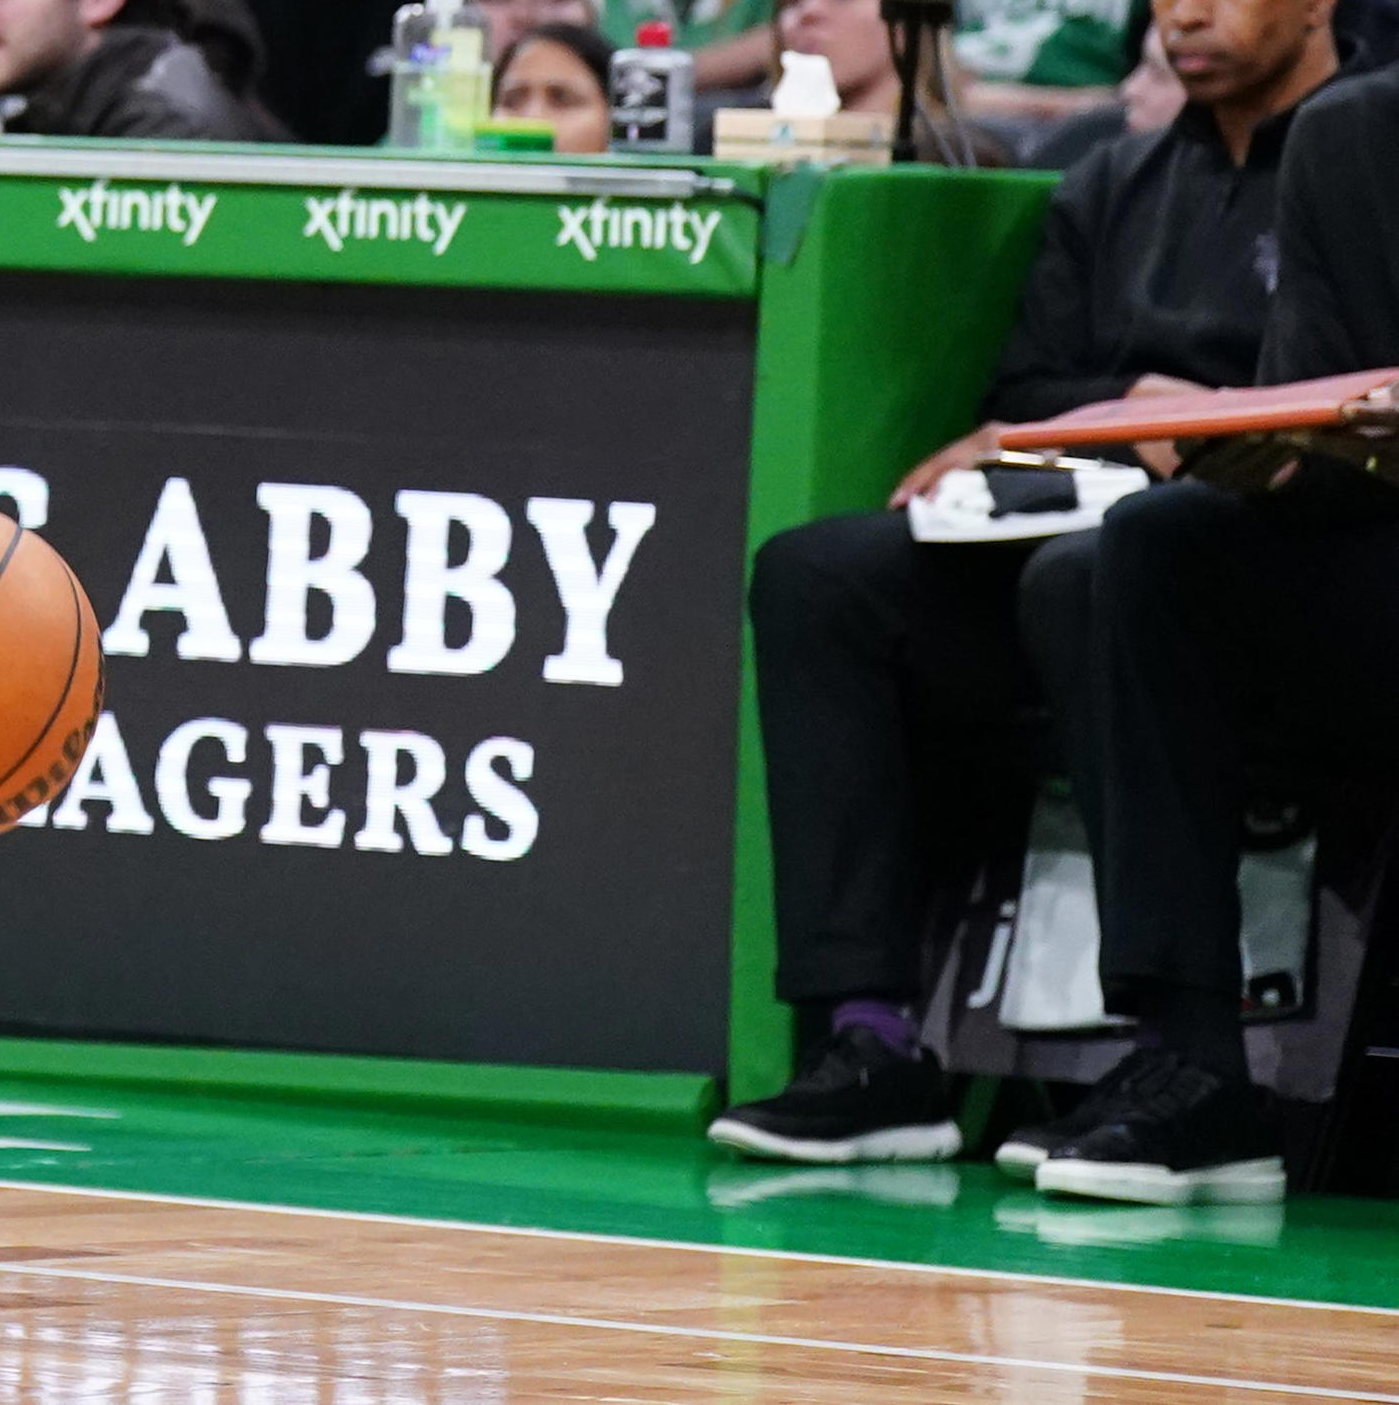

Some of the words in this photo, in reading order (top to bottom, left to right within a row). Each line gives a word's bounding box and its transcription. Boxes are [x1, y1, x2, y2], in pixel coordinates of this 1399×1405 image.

[57, 179, 217, 246] xfinity
[304, 188, 467, 255] xfinity
[557, 197, 721, 265] xfinity
[104, 477, 657, 687] ABBY
[13, 712, 540, 862] AGERS
